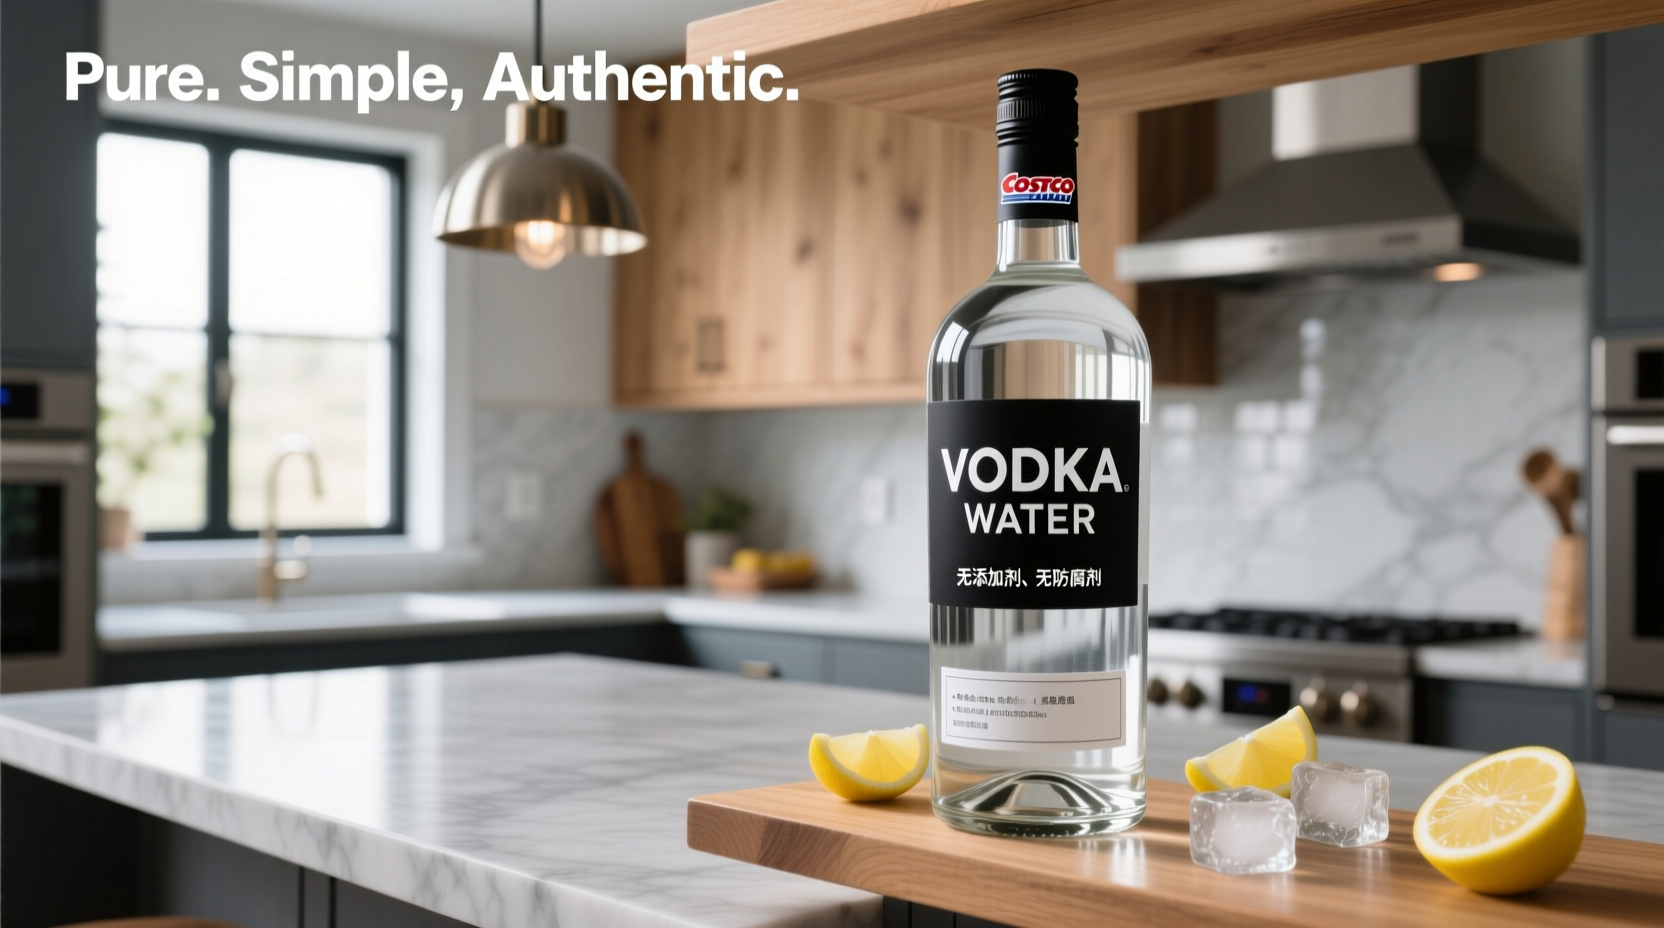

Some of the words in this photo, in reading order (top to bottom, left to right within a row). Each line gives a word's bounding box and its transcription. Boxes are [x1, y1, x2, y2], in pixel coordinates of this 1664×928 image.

[1001, 172, 1075, 195] COSTCO
[941, 447, 1123, 492] VODKA
[964, 503, 1095, 534] WATER
